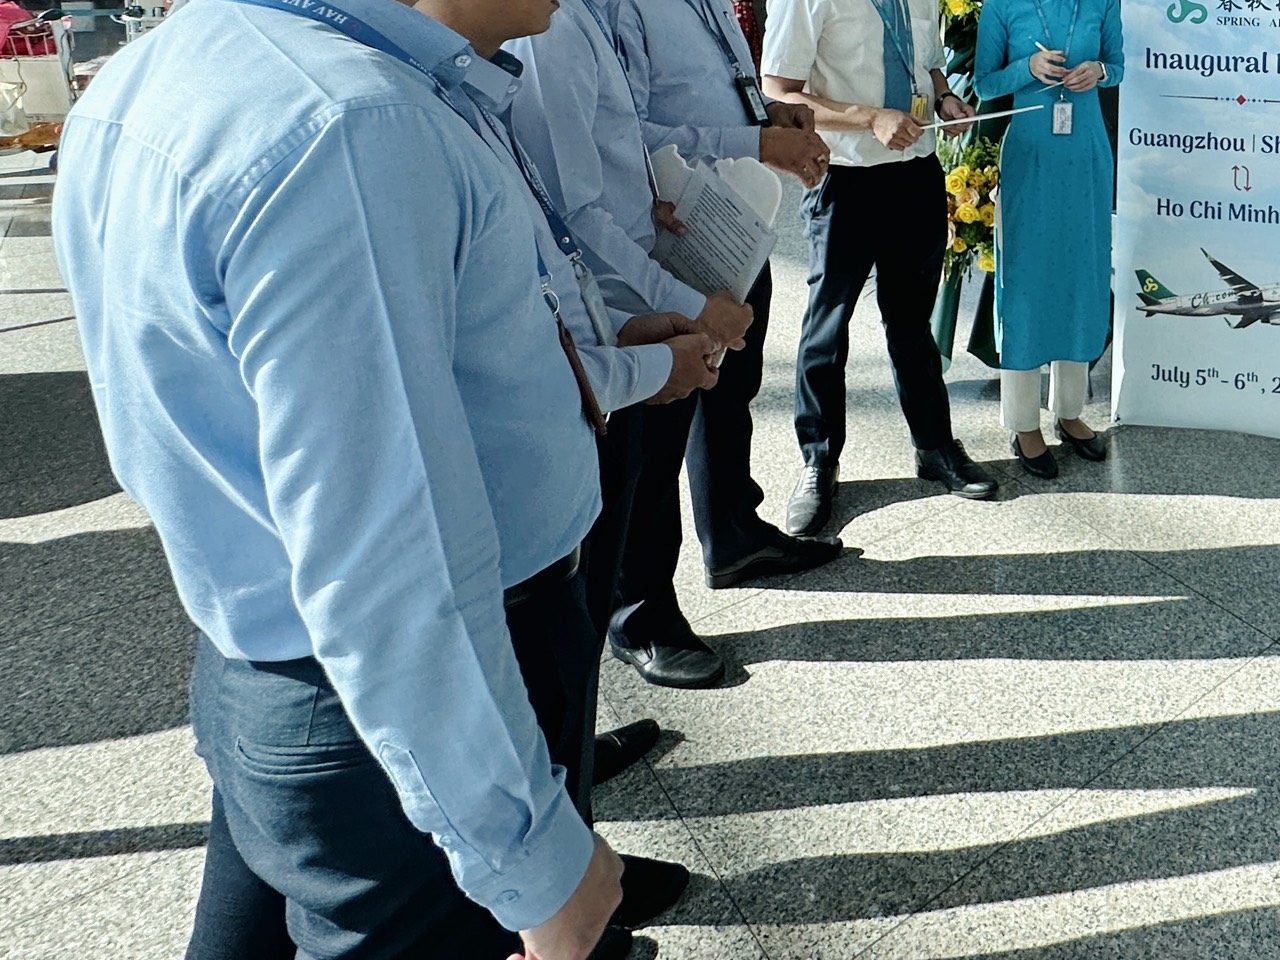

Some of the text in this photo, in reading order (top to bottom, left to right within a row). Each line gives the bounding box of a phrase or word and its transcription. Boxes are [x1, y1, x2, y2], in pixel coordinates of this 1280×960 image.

[312, 7, 349, 24] HAV
[1216, 15, 1260, 28] SPRING
[1145, 47, 1269, 77] Inaugural
[1129, 127, 1246, 154] Guangzhou
[1156, 198, 1185, 217] Ho
[1190, 200, 1223, 221] Chi
[1228, 202, 1280, 225] Minh
[1151, 364, 1191, 389] July
